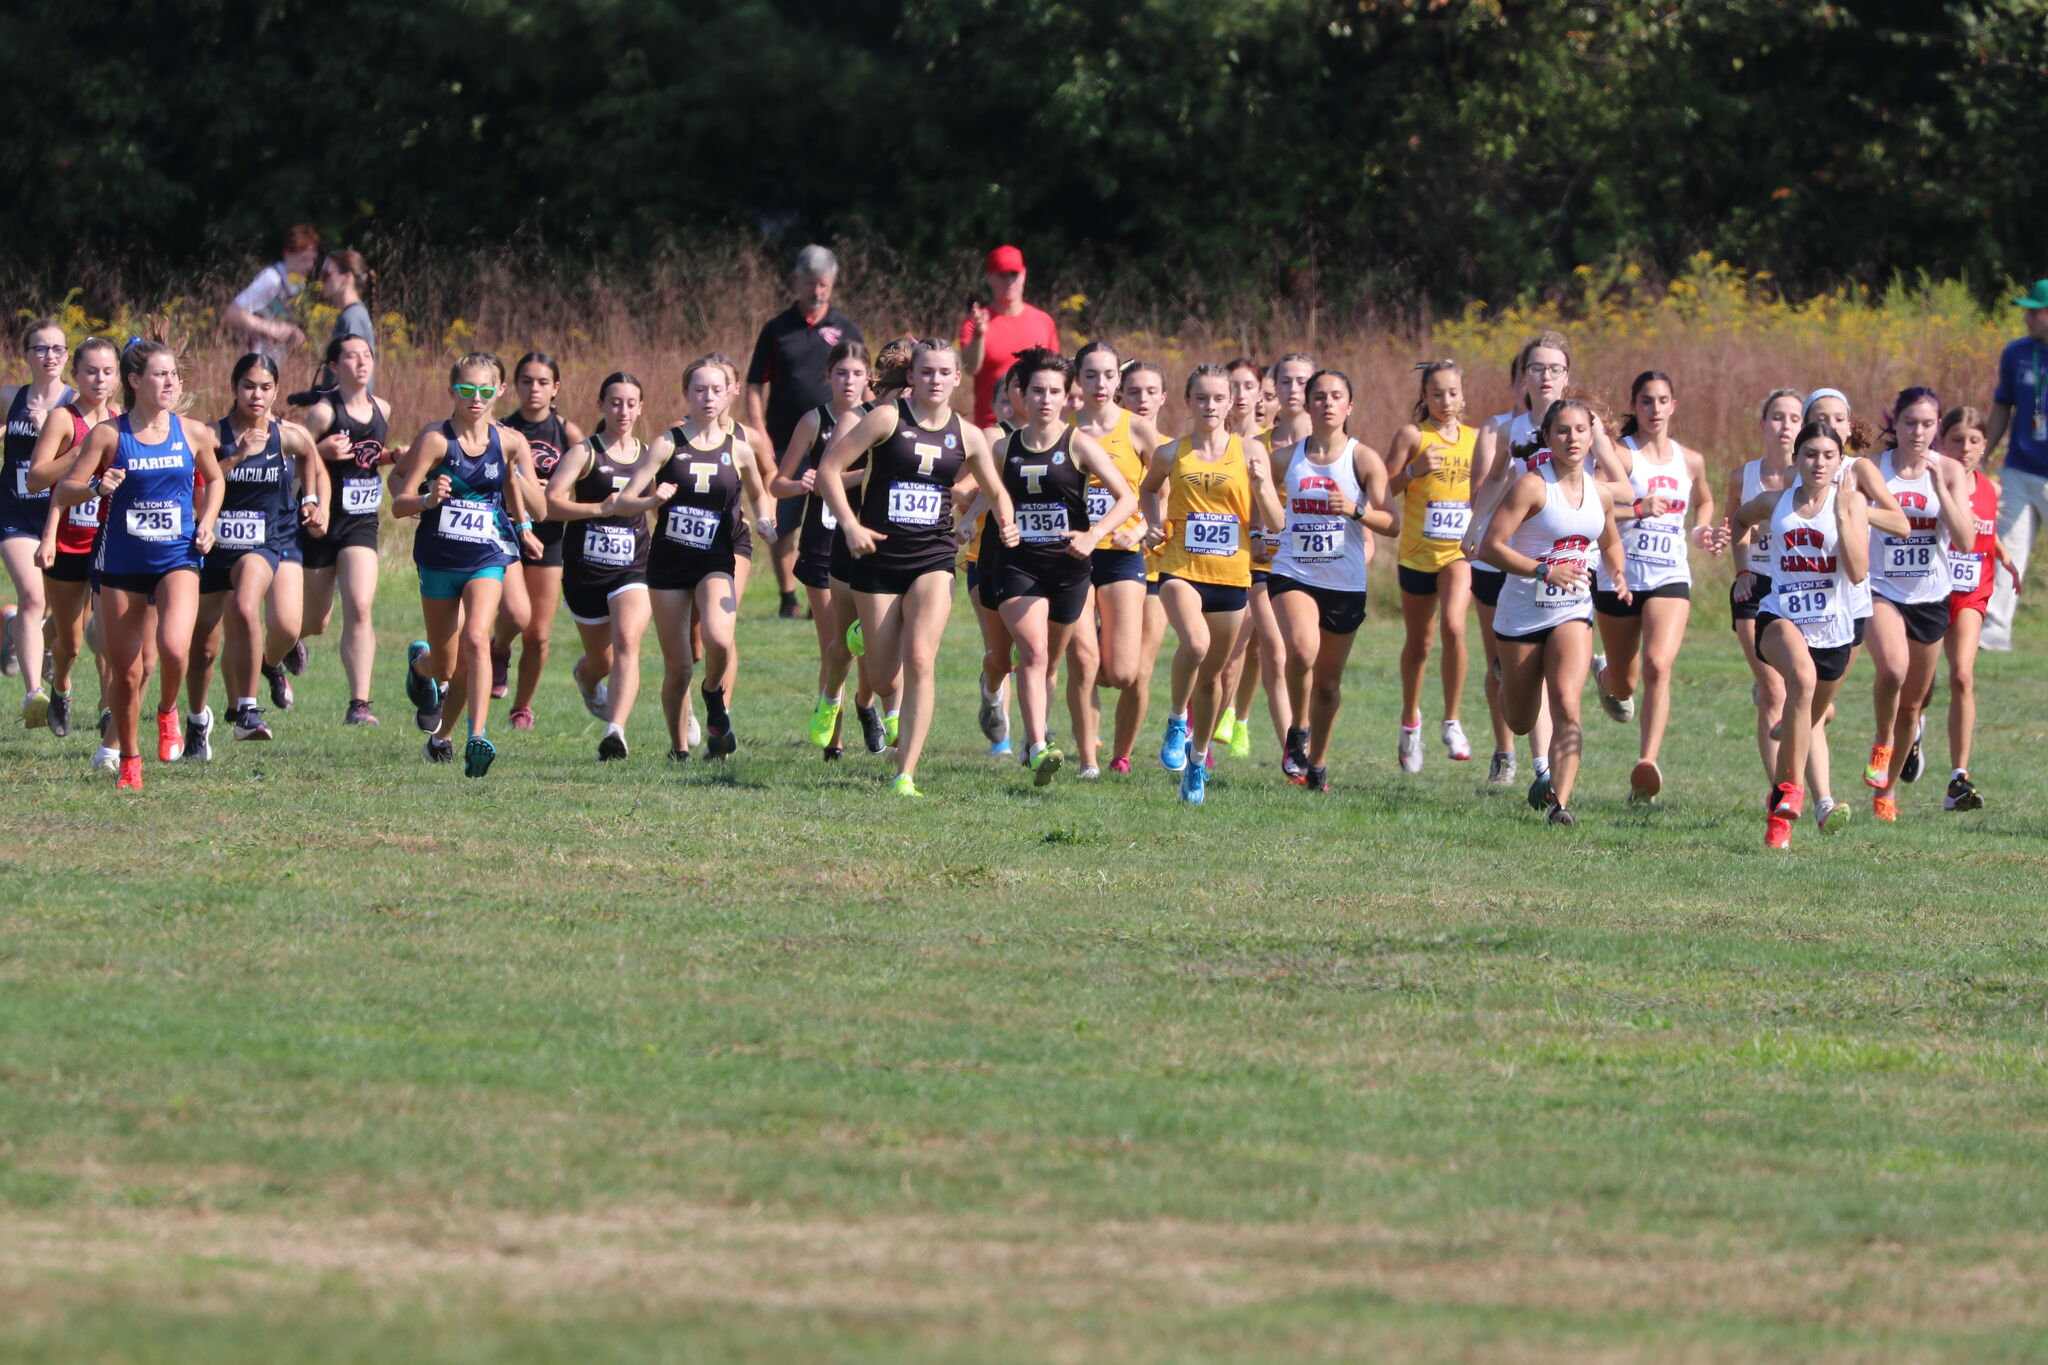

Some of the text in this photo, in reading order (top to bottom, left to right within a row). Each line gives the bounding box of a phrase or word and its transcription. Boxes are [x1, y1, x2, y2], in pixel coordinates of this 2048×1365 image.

[128, 455, 184, 471] DARIEN
[914, 442, 942, 476] T
[689, 462, 718, 493] T
[897, 481, 925, 490] WILTON
[1019, 464, 1048, 494] T
[1299, 476, 1338, 492] NEW
[1647, 475, 1679, 493] NEW
[133, 501, 162, 509] WILTON
[350, 488, 378, 505] 975
[450, 499, 477, 509] WILTON
[892, 493, 939, 512] 1347
[75, 500, 96, 516] 16
[248, 510, 259, 518] XC
[676, 506, 704, 516] WILTON
[1022, 502, 1060, 511] WILTON XC
[1292, 498, 1343, 515] CANA
[135, 512, 173, 530] 235
[449, 510, 484, 531] 744
[1018, 513, 1066, 531] 1354
[1193, 512, 1233, 522] WILTON XC
[1432, 512, 1464, 528] 942
[220, 522, 257, 539] 603
[670, 516, 715, 540] 1361
[1194, 524, 1230, 544] 925
[445, 533, 481, 544] INVITATIONAL
[588, 534, 632, 555] 1359
[1300, 534, 1334, 552] 781
[1551, 534, 1590, 553] NEW
[1637, 533, 1671, 553] 810
[1783, 528, 1824, 551] NEW
[1192, 548, 1228, 556] INVITATIONAL
[1893, 548, 1930, 566] 818
[1780, 555, 1837, 573] CANAAN
[1786, 580, 1826, 590] WILTON XC
[1788, 592, 1827, 613] 819
